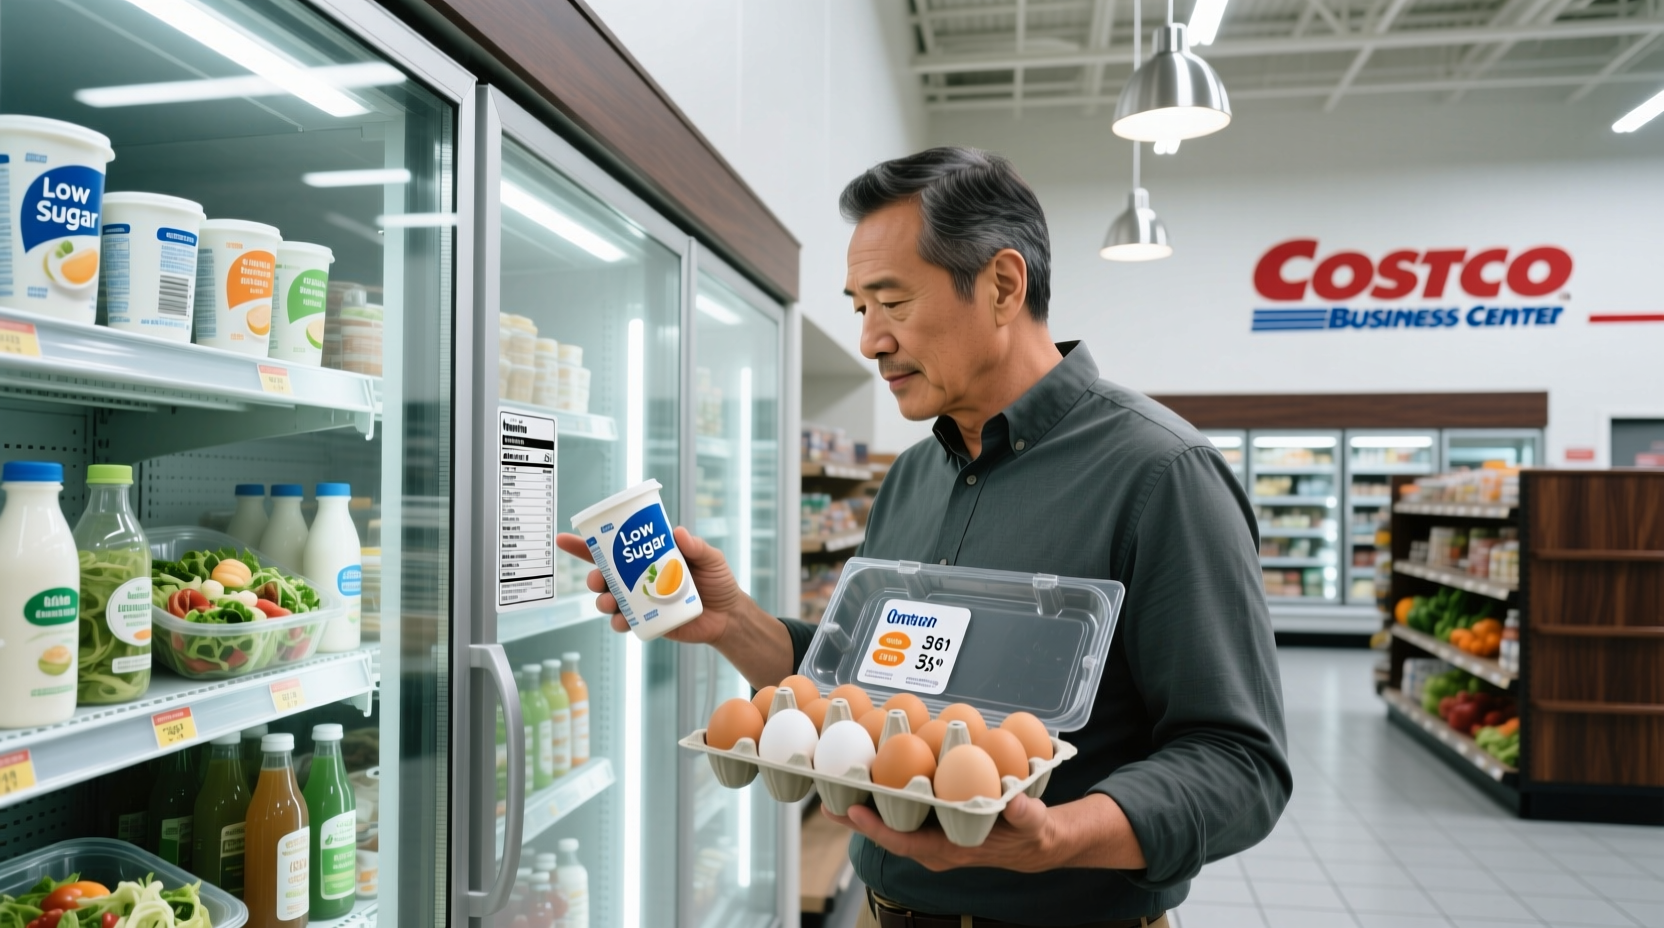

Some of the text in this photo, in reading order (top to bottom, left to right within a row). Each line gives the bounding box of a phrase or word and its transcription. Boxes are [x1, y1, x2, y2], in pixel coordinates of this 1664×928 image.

[43, 177, 91, 204] Low
[36, 200, 98, 231] Sugar
[1253, 238, 1573, 301] COSTCO
[1328, 307, 1459, 329] BUSINESS
[619, 522, 654, 546] Low
[622, 534, 666, 563] Sugar
